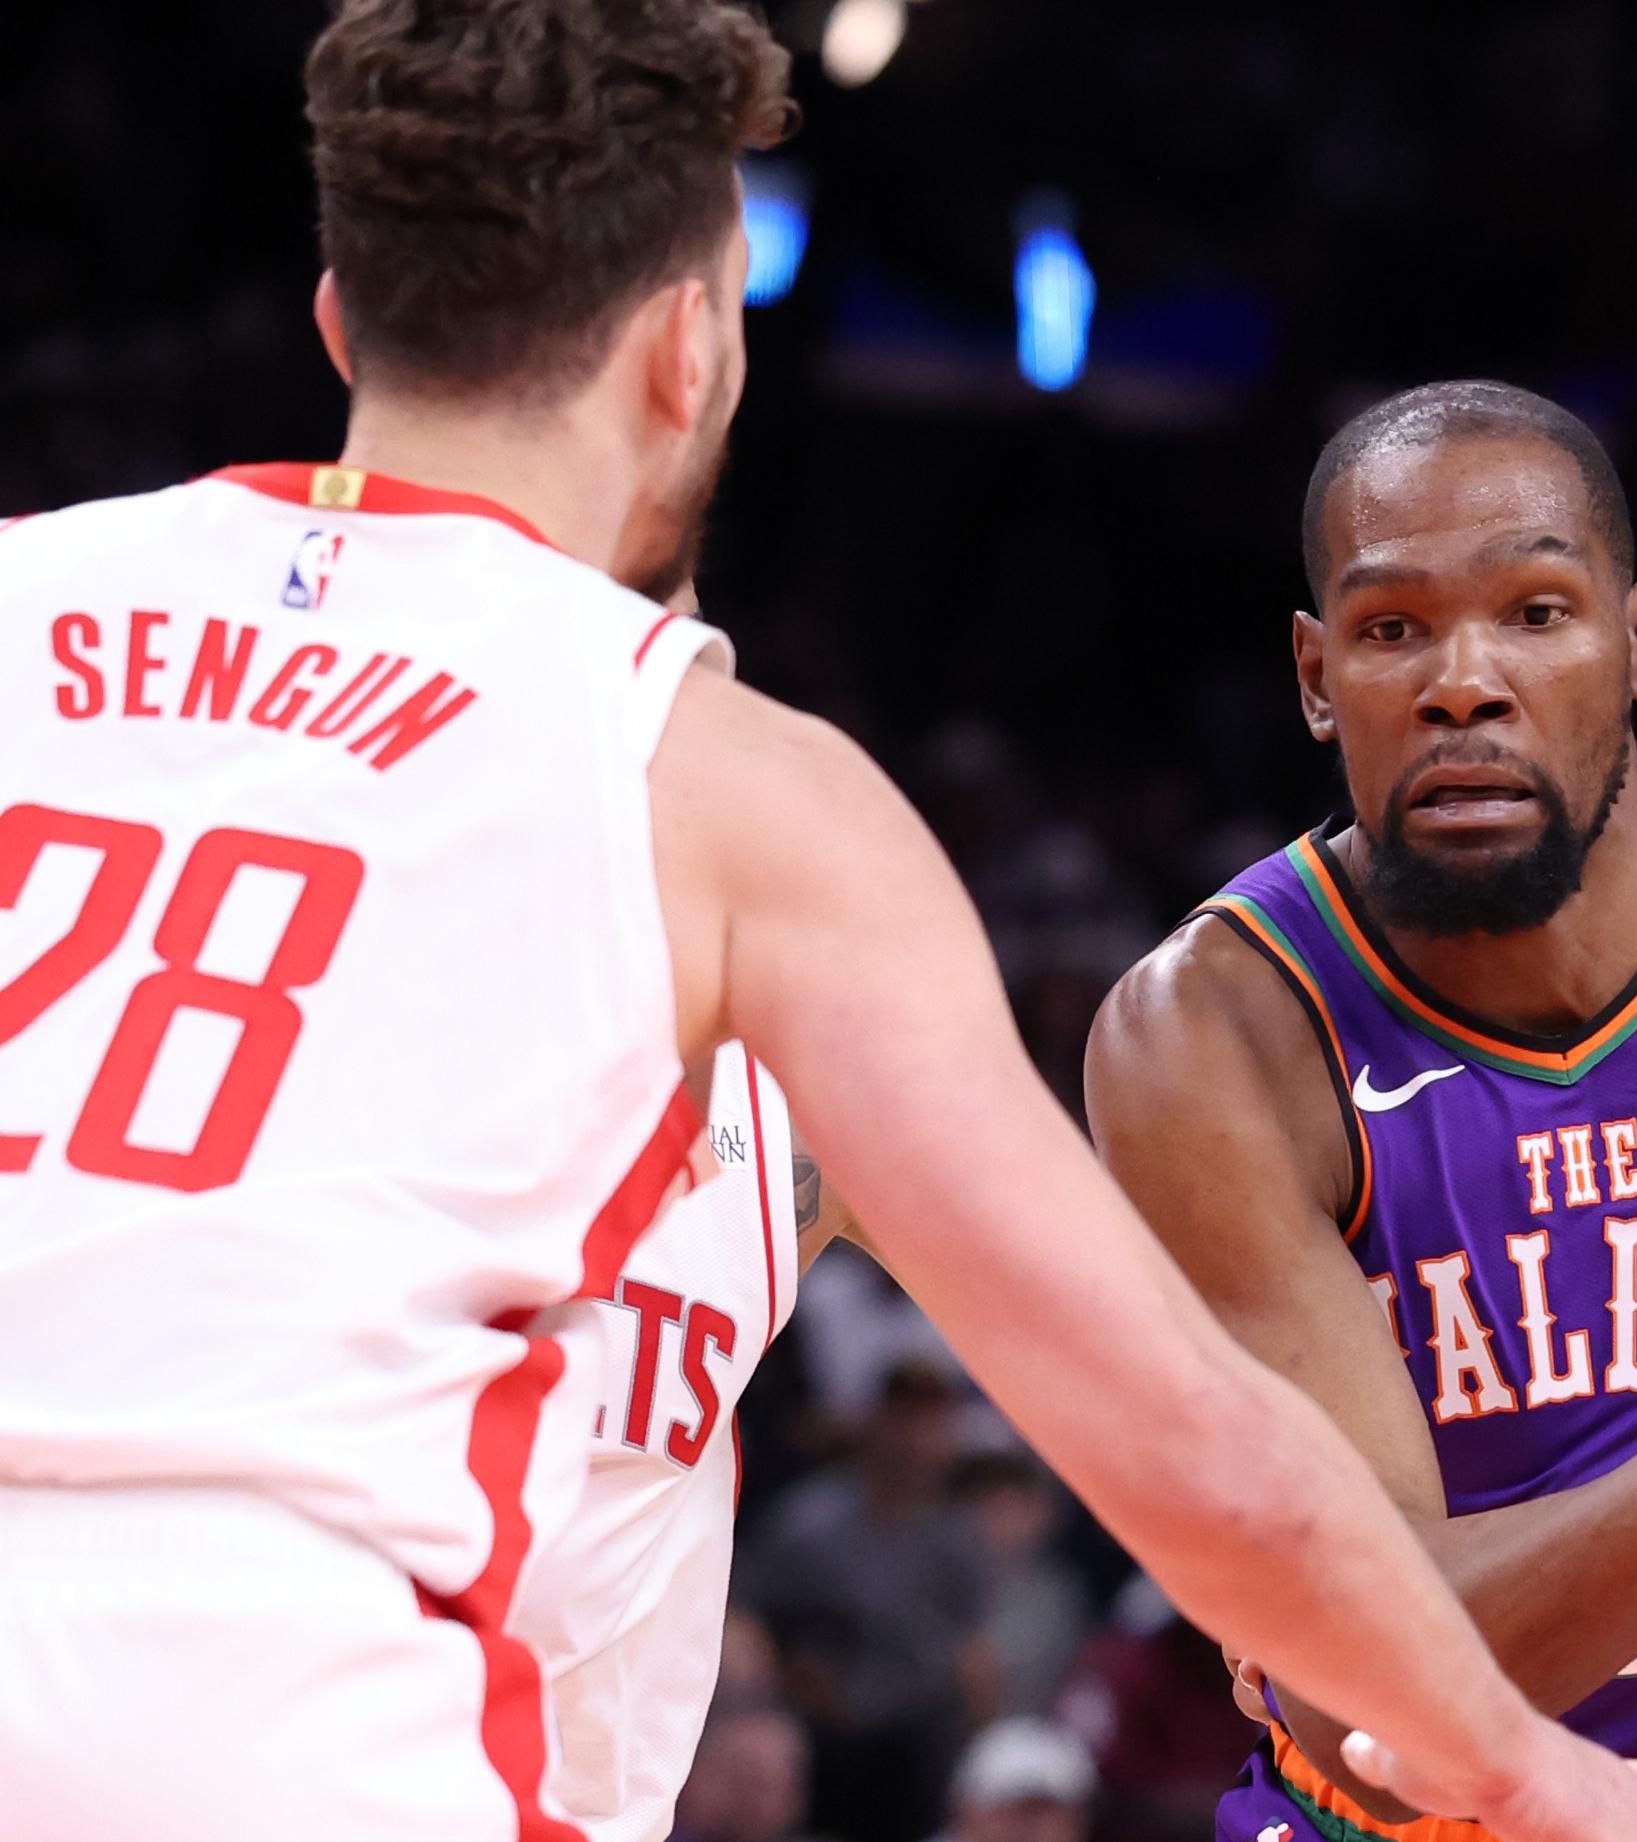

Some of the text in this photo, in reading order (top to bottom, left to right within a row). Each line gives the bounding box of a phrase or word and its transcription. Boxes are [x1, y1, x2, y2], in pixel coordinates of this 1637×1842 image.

[51, 610, 479, 772] SENGUN
[0, 802, 366, 1193] 28
[594, 1275, 737, 1471] TS
